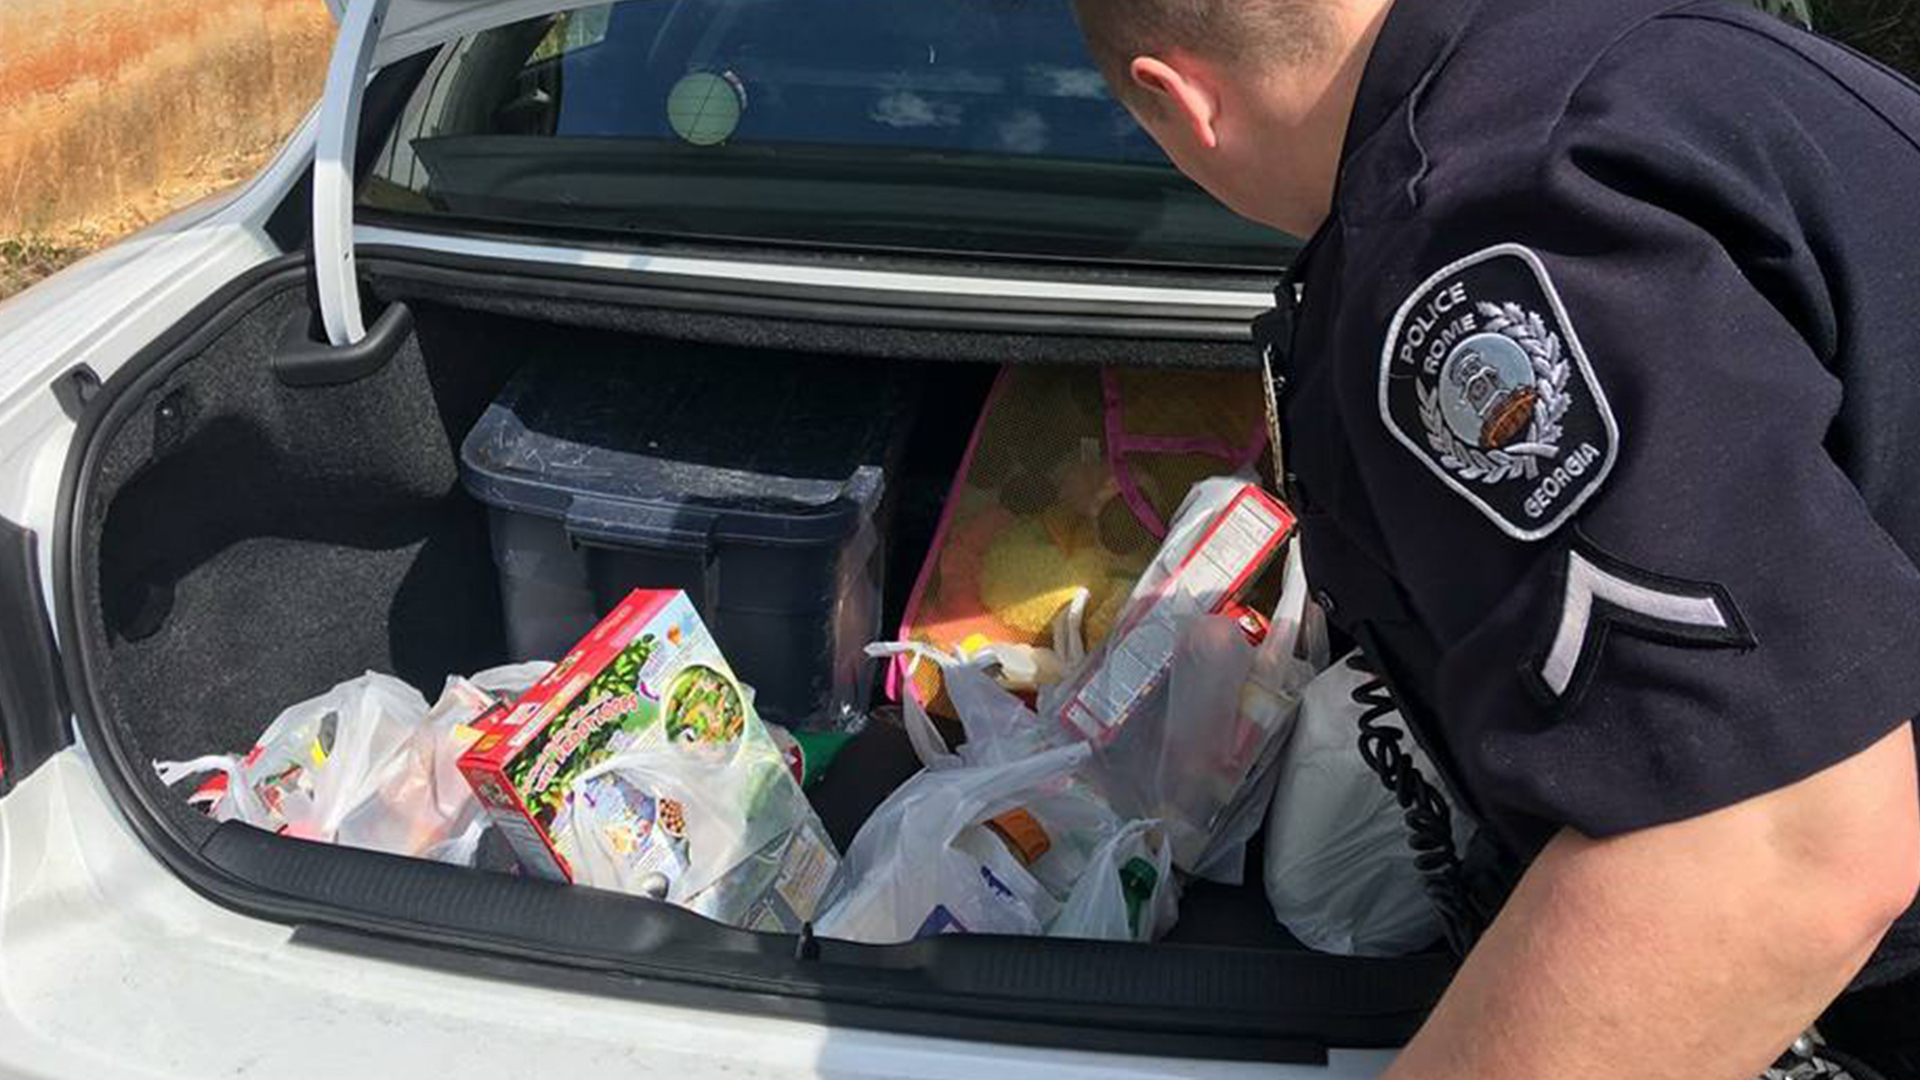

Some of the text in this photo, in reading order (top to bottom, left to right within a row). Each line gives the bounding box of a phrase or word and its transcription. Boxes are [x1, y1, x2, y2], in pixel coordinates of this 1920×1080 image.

[1400, 281, 1467, 365] POLICE
[1423, 313, 1478, 375] ROME
[1523, 442, 1601, 519] GEORGIA
